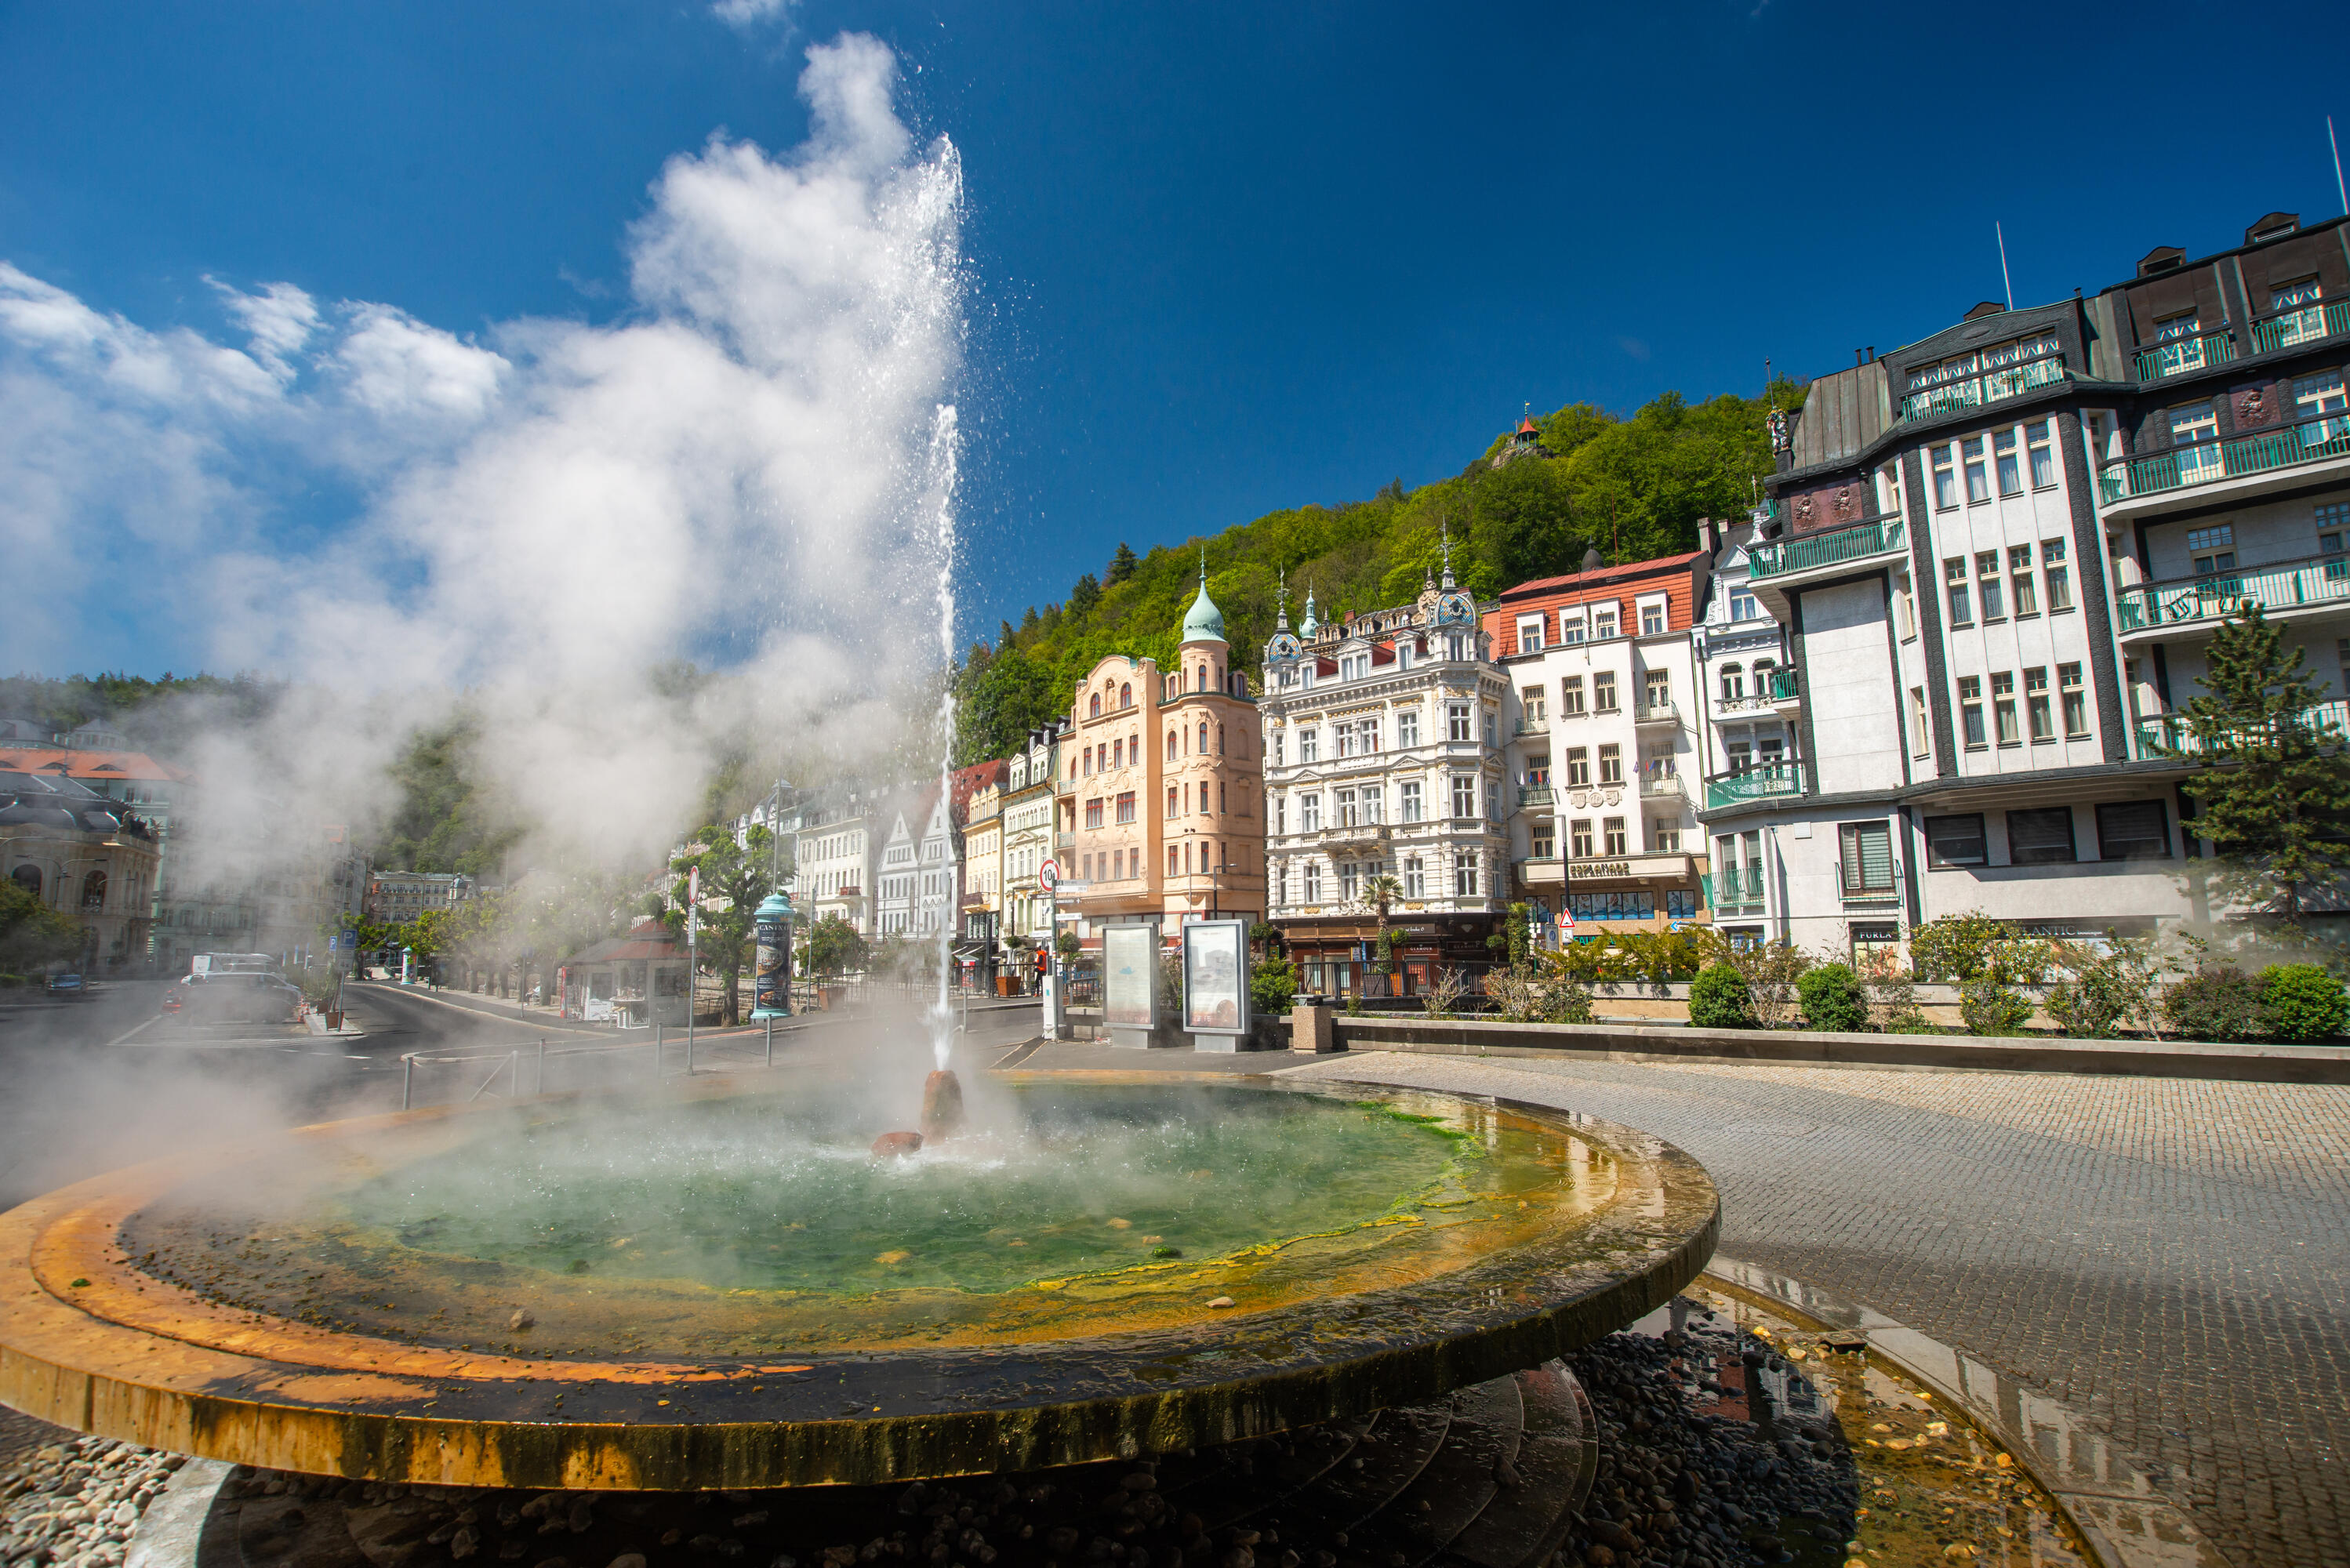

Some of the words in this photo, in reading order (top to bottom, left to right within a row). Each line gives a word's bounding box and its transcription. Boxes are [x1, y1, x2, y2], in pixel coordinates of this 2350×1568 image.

[1570, 862, 1630, 875] ESPLANADE
[1044, 869, 1052, 880] 10
[345, 932, 353, 943] P
